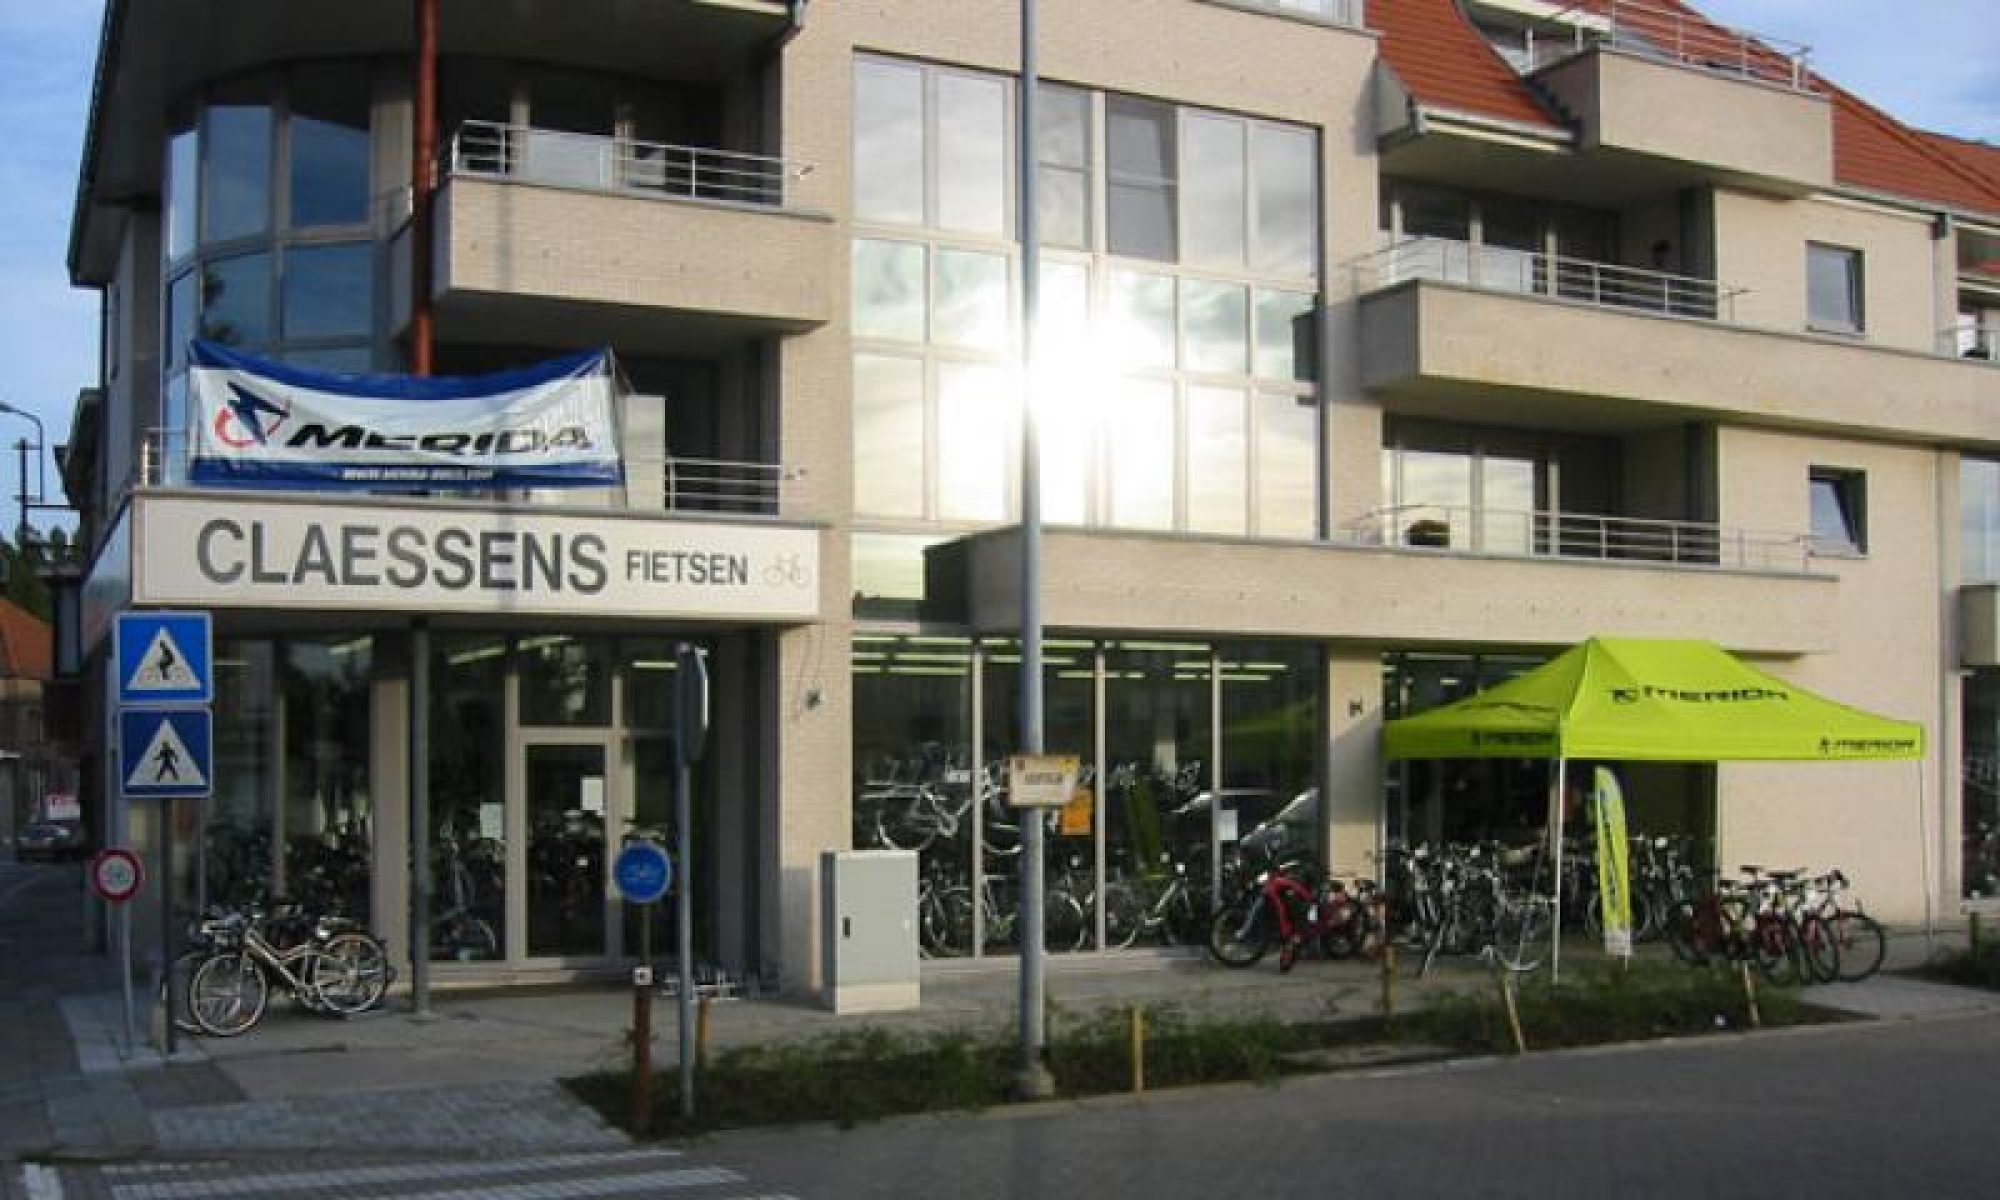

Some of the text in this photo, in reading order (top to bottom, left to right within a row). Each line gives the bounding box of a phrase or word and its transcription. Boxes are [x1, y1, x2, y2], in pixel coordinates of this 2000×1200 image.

[284, 423, 593, 456] MERIDA
[196, 519, 748, 595] CLAESSENS FIETSEN
